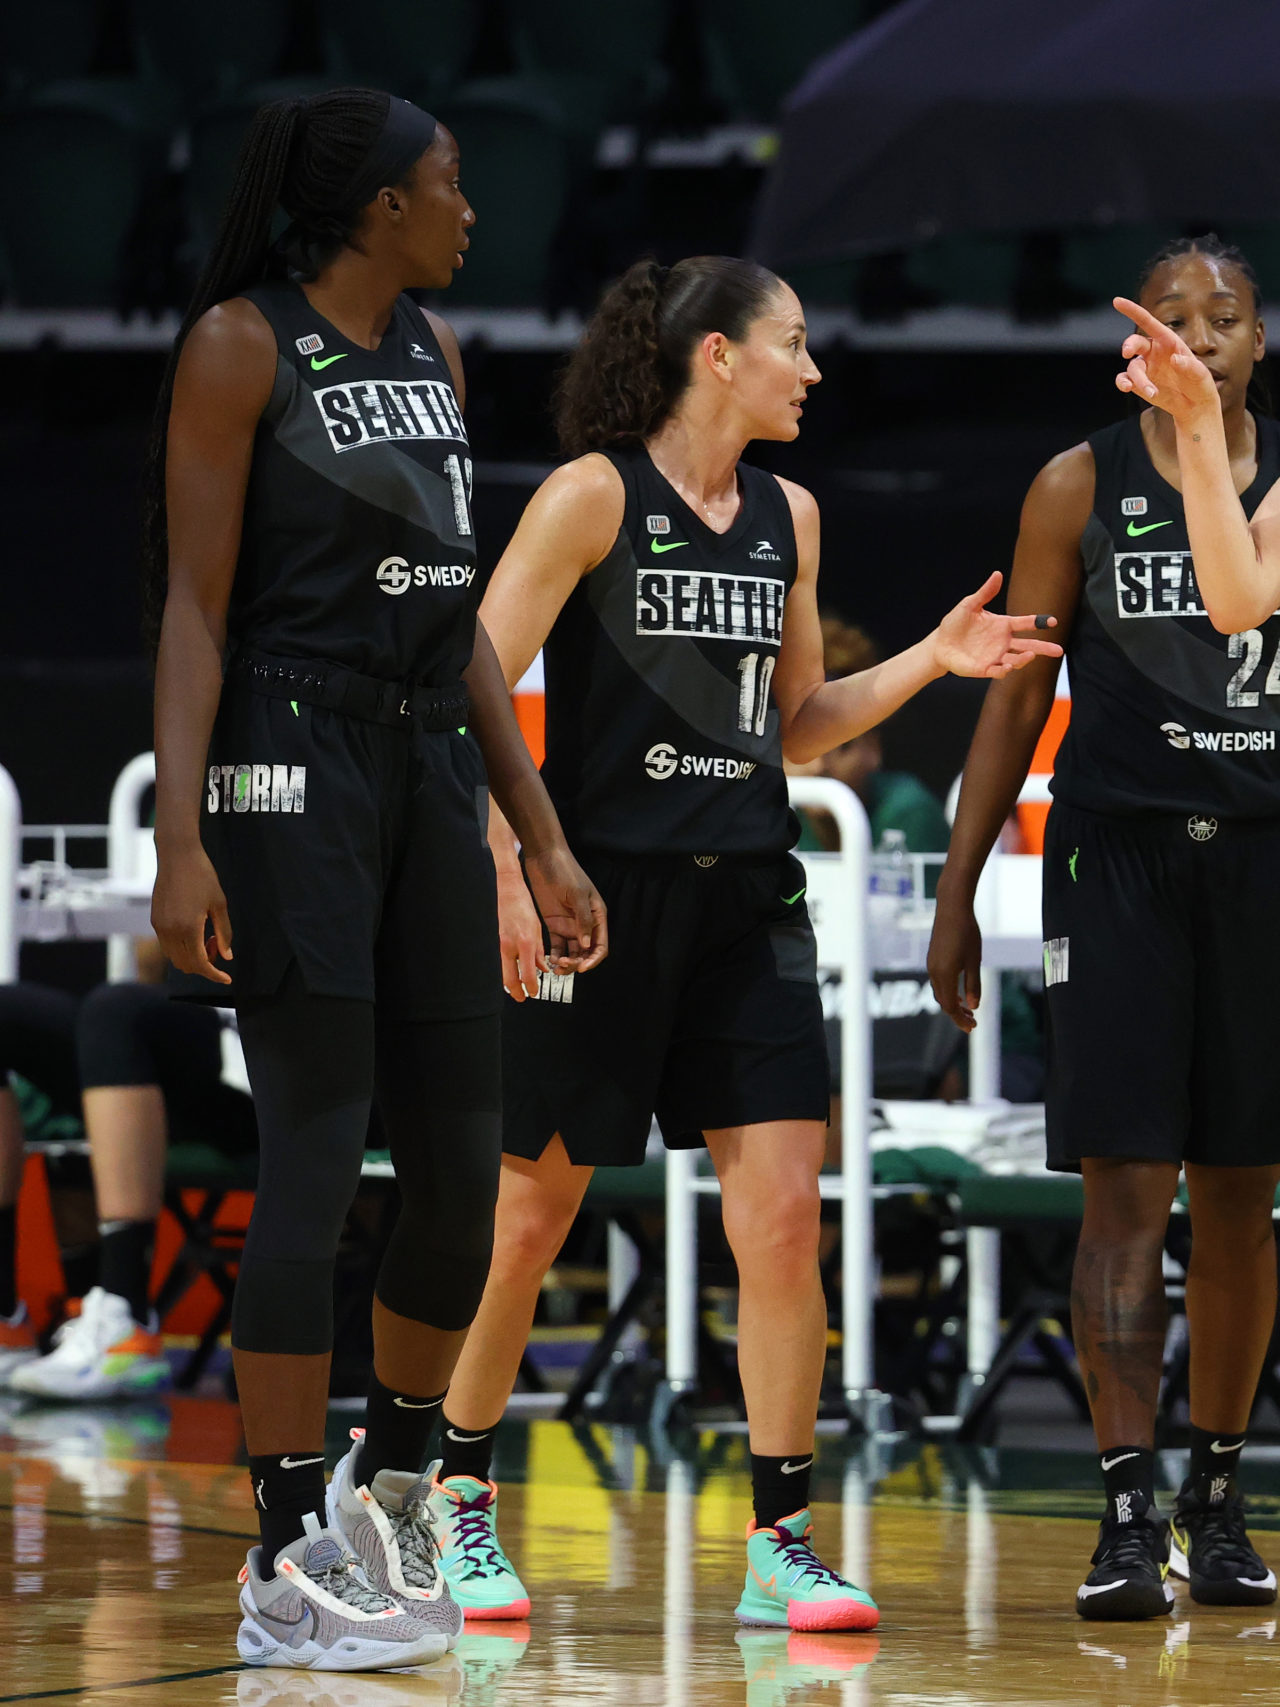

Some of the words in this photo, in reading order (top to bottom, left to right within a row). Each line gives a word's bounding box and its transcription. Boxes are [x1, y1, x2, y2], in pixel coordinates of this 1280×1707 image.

[749, 551, 782, 562] SYMETRA
[640, 573, 783, 641] SEATTLE
[737, 652, 776, 737] 10
[1193, 730, 1276, 752] SWEDISH
[207, 764, 307, 815] STORM
